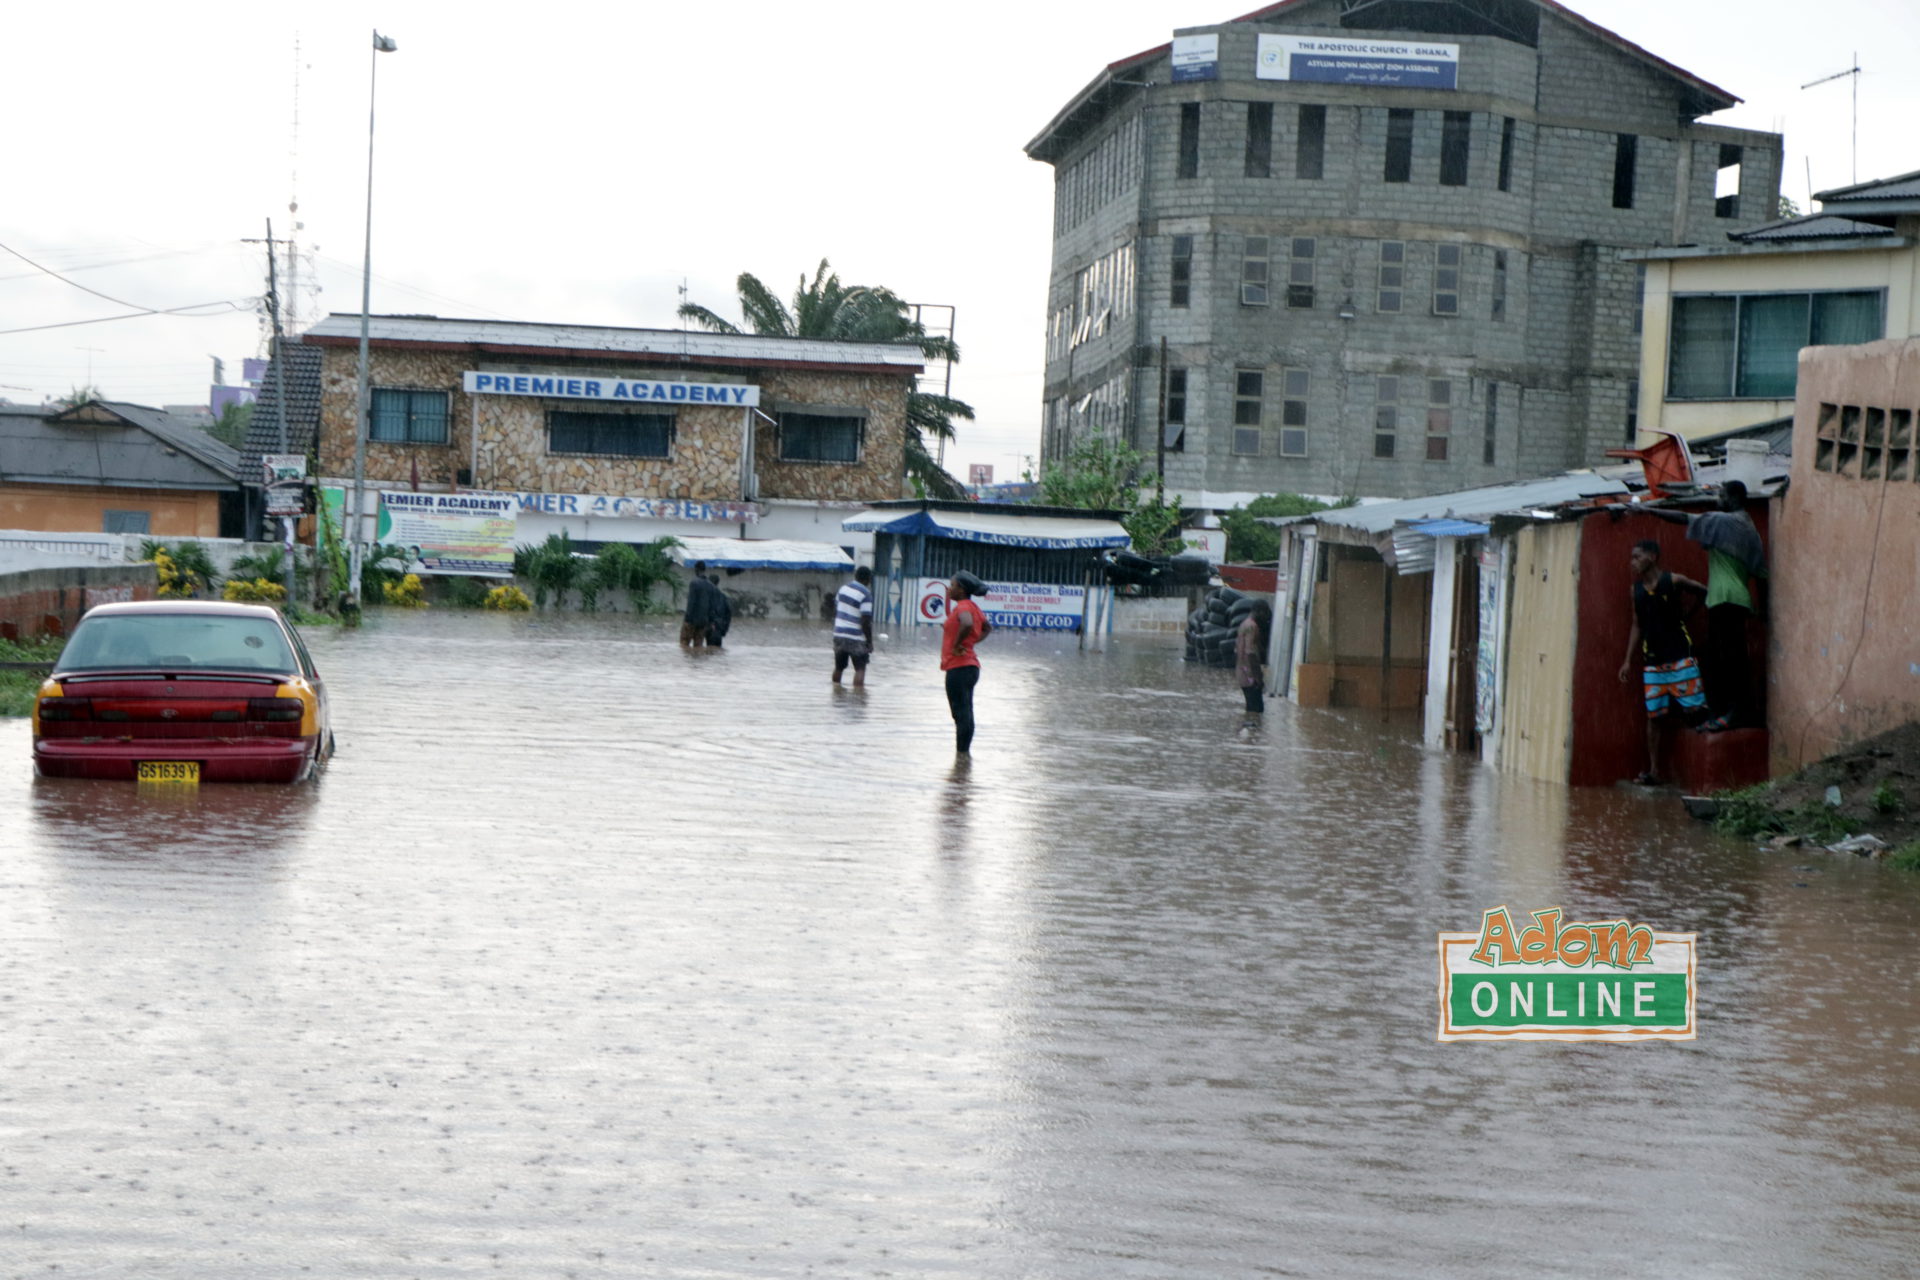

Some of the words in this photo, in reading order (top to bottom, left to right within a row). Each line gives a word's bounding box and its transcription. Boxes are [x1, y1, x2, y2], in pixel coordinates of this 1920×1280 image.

[1298, 42, 1315, 50] THE
[1317, 43, 1368, 53] APOSTOLIC
[1370, 45, 1408, 54] CHURCH
[1336, 60, 1358, 69] DOWN
[1360, 61, 1385, 70] MOUNT
[1386, 63, 1404, 71] ZION
[475, 374, 602, 397] PREMIER
[613, 382, 748, 404] ACADEMY
[380, 493, 434, 507] REMIER
[437, 496, 511, 511] ACADEMY
[948, 527, 975, 540] JOE
[1047, 538, 1078, 549] HAIR
[1080, 537, 1105, 548] CUT
[995, 612, 1025, 626] CITY
[1026, 613, 1045, 627] OF
[1045, 614, 1073, 628] GOD
